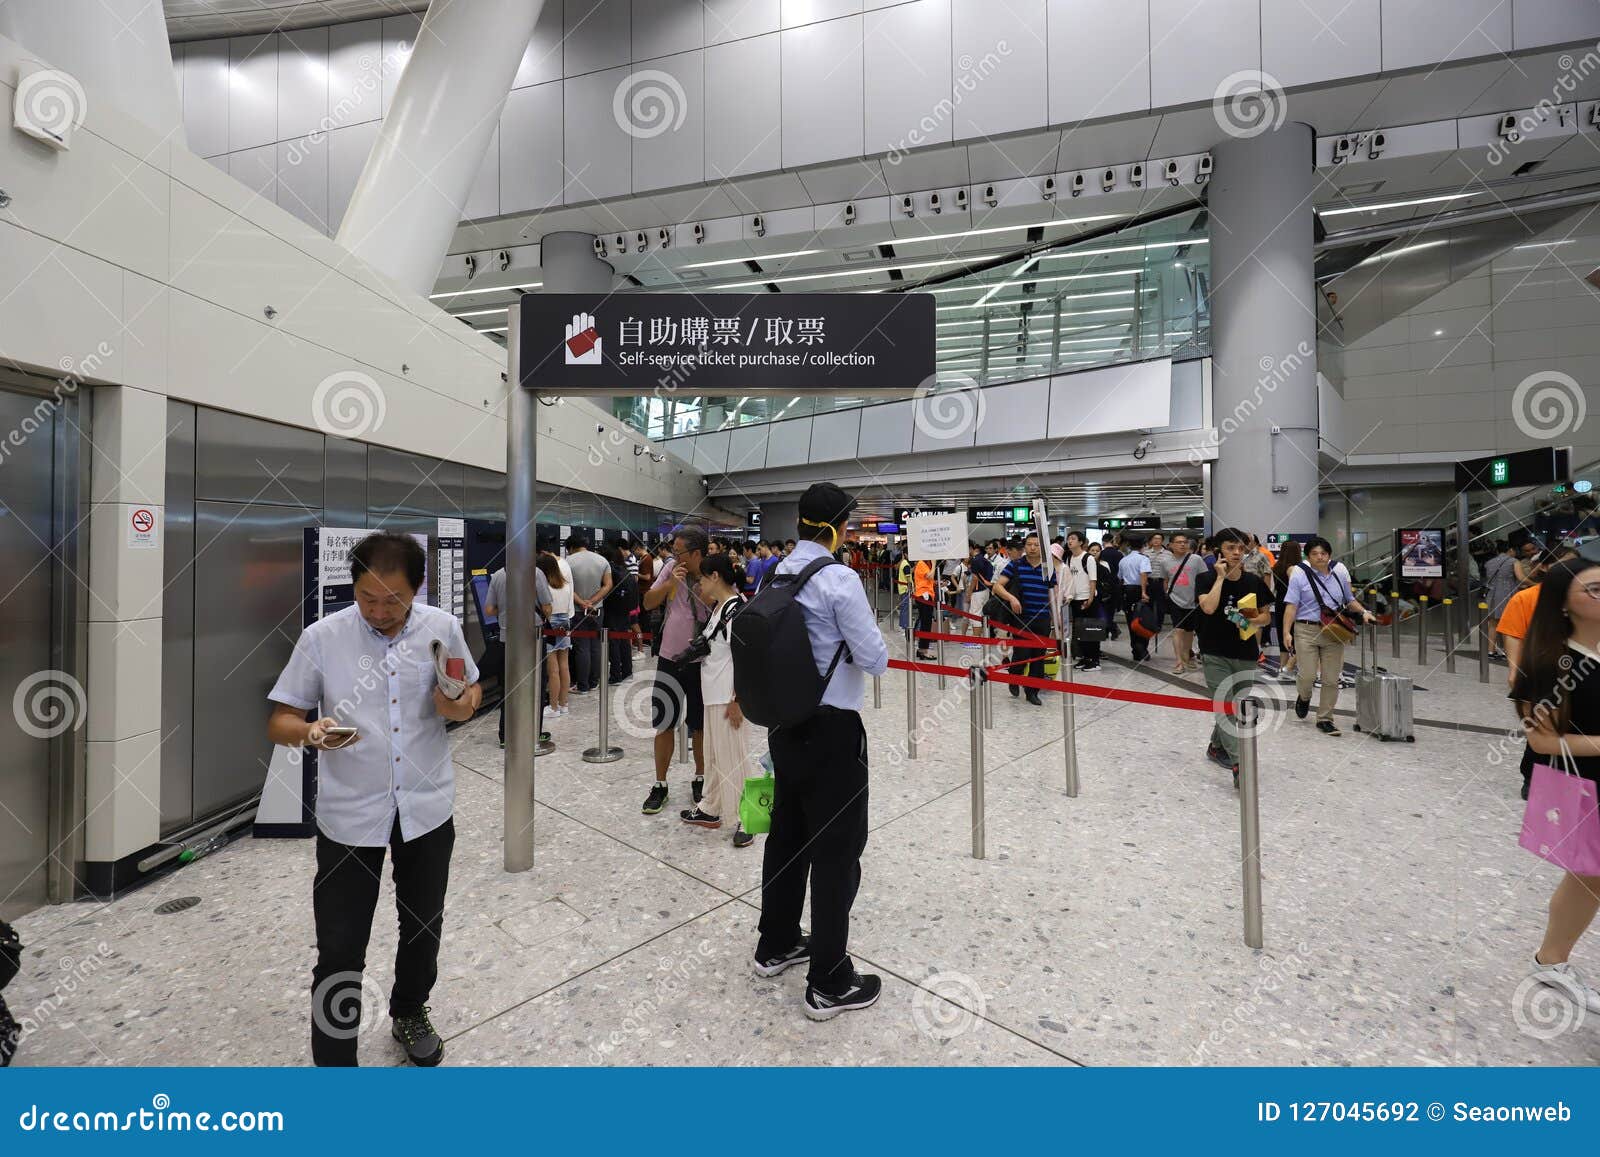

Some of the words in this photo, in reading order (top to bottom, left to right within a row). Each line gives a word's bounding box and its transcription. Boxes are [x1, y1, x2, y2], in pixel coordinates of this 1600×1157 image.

[619, 316, 826, 346] 自助購票/取票
[619, 351, 696, 367] Self-service
[699, 351, 736, 367] ticket
